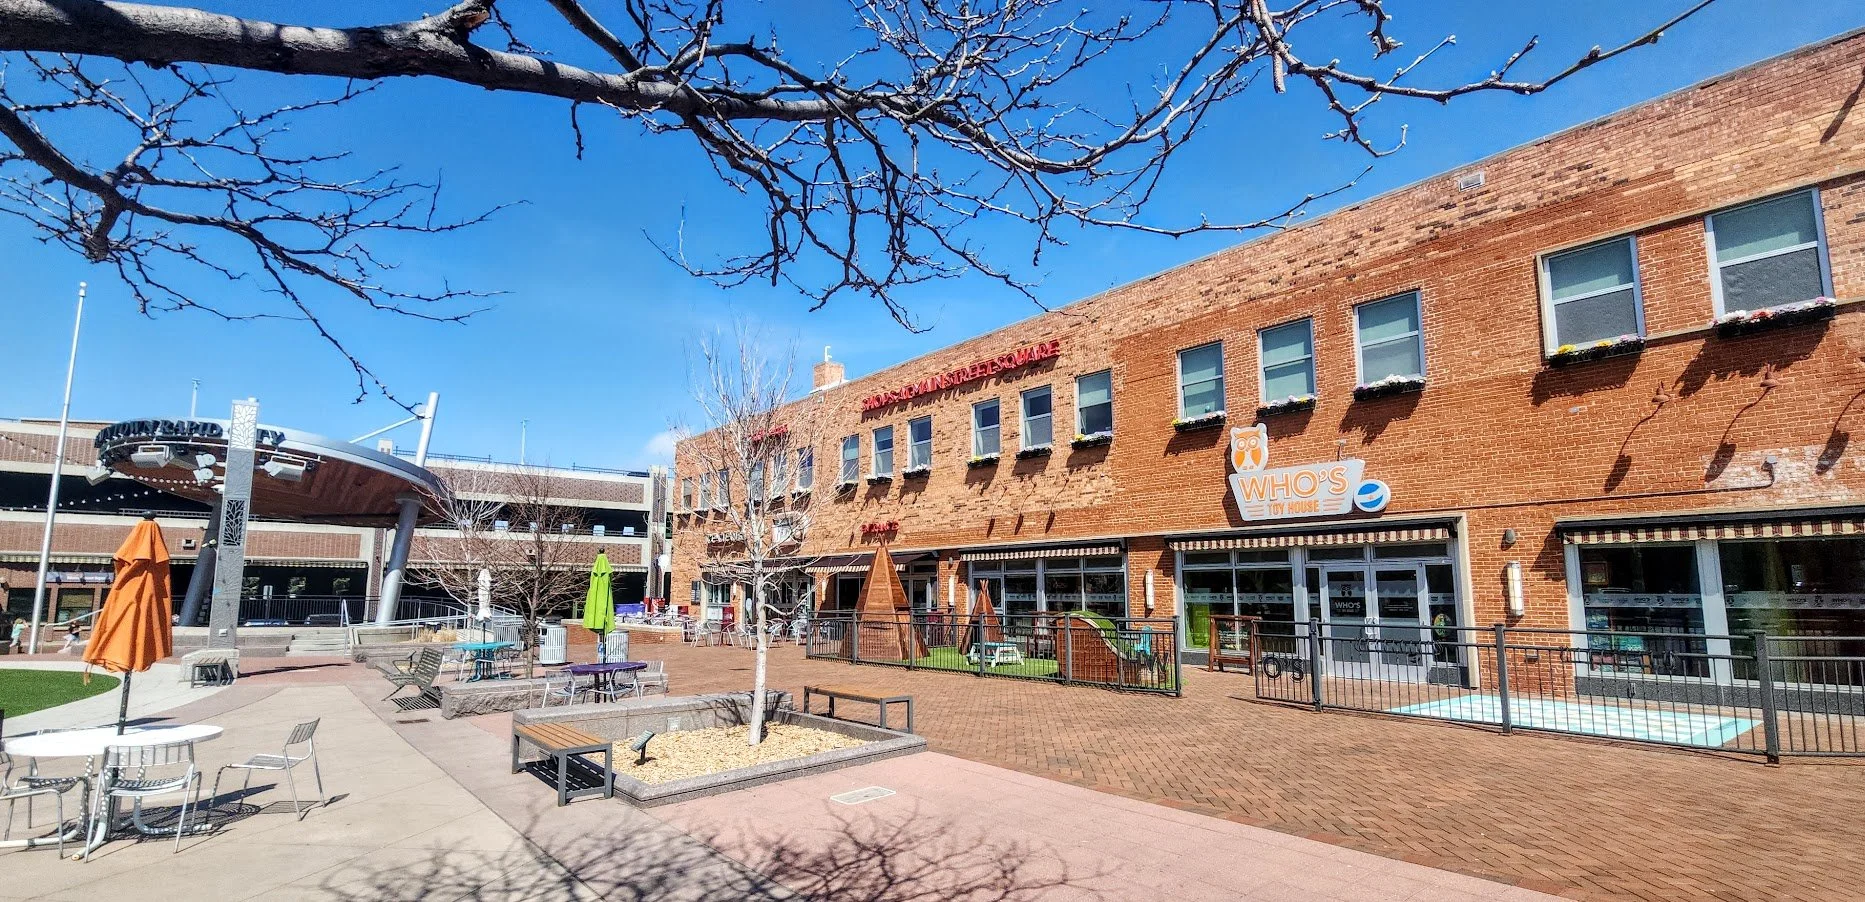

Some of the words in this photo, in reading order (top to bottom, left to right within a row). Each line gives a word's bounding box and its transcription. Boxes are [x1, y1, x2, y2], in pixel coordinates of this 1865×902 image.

[913, 371, 946, 396] MAIN
[945, 358, 995, 388] STREET
[994, 339, 1060, 371] SQUARE
[160, 419, 223, 437] RAPID
[1237, 465, 1349, 502] WHO'S
[1268, 503, 1286, 515] TOY
[1288, 500, 1319, 514] HOUSE
